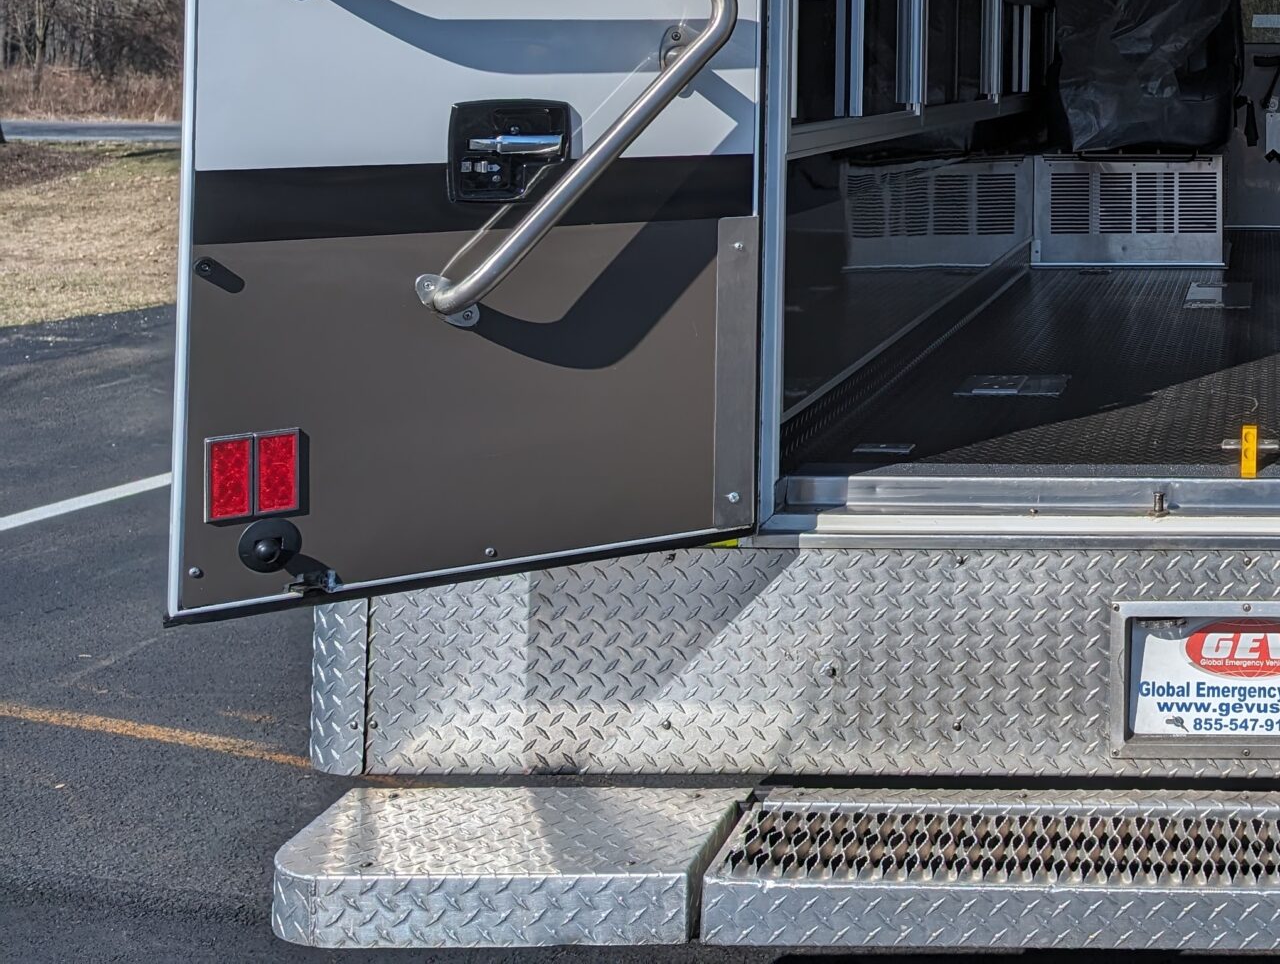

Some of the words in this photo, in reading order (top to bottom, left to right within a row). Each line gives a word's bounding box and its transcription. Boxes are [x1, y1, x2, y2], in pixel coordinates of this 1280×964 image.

[1200, 658, 1224, 666] Global
[1225, 658, 1264, 668] Emergency
[1139, 681, 1191, 698] Global
